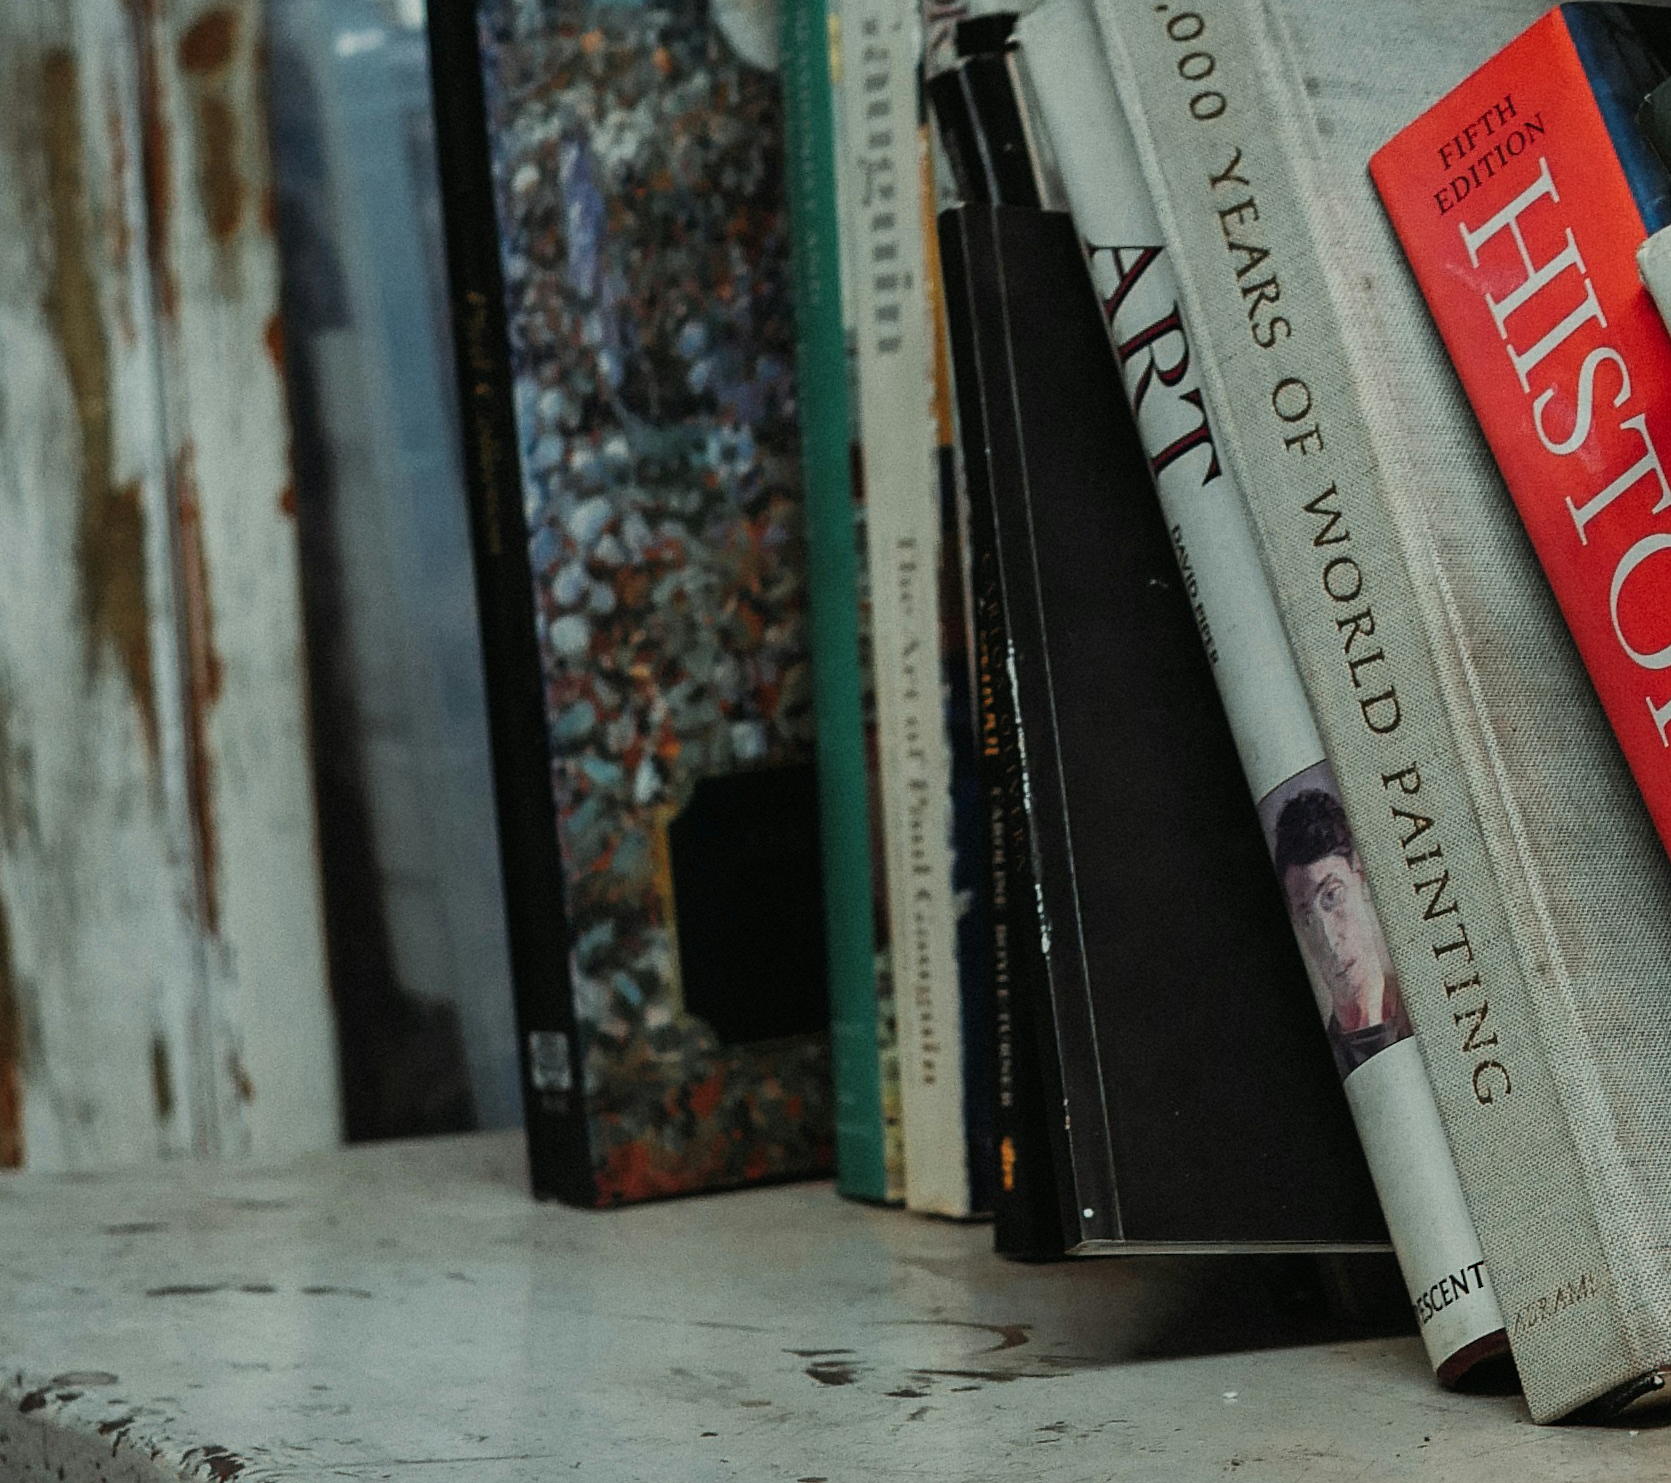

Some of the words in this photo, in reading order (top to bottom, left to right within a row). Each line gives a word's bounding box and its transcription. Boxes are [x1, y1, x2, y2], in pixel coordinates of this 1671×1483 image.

[1433, 113, 1548, 216] EDITION
[1437, 93, 1519, 171] FIFTH
[1085, 243, 1222, 486] ART
[1172, 525, 1198, 598] DAVID
[1209, 147, 1292, 350] YEARS
[1270, 377, 1325, 456] OF
[1301, 481, 1401, 735] WORLD
[1381, 761, 1513, 1106] PAINTING
[1413, 1260, 1485, 1324] ESCENT
